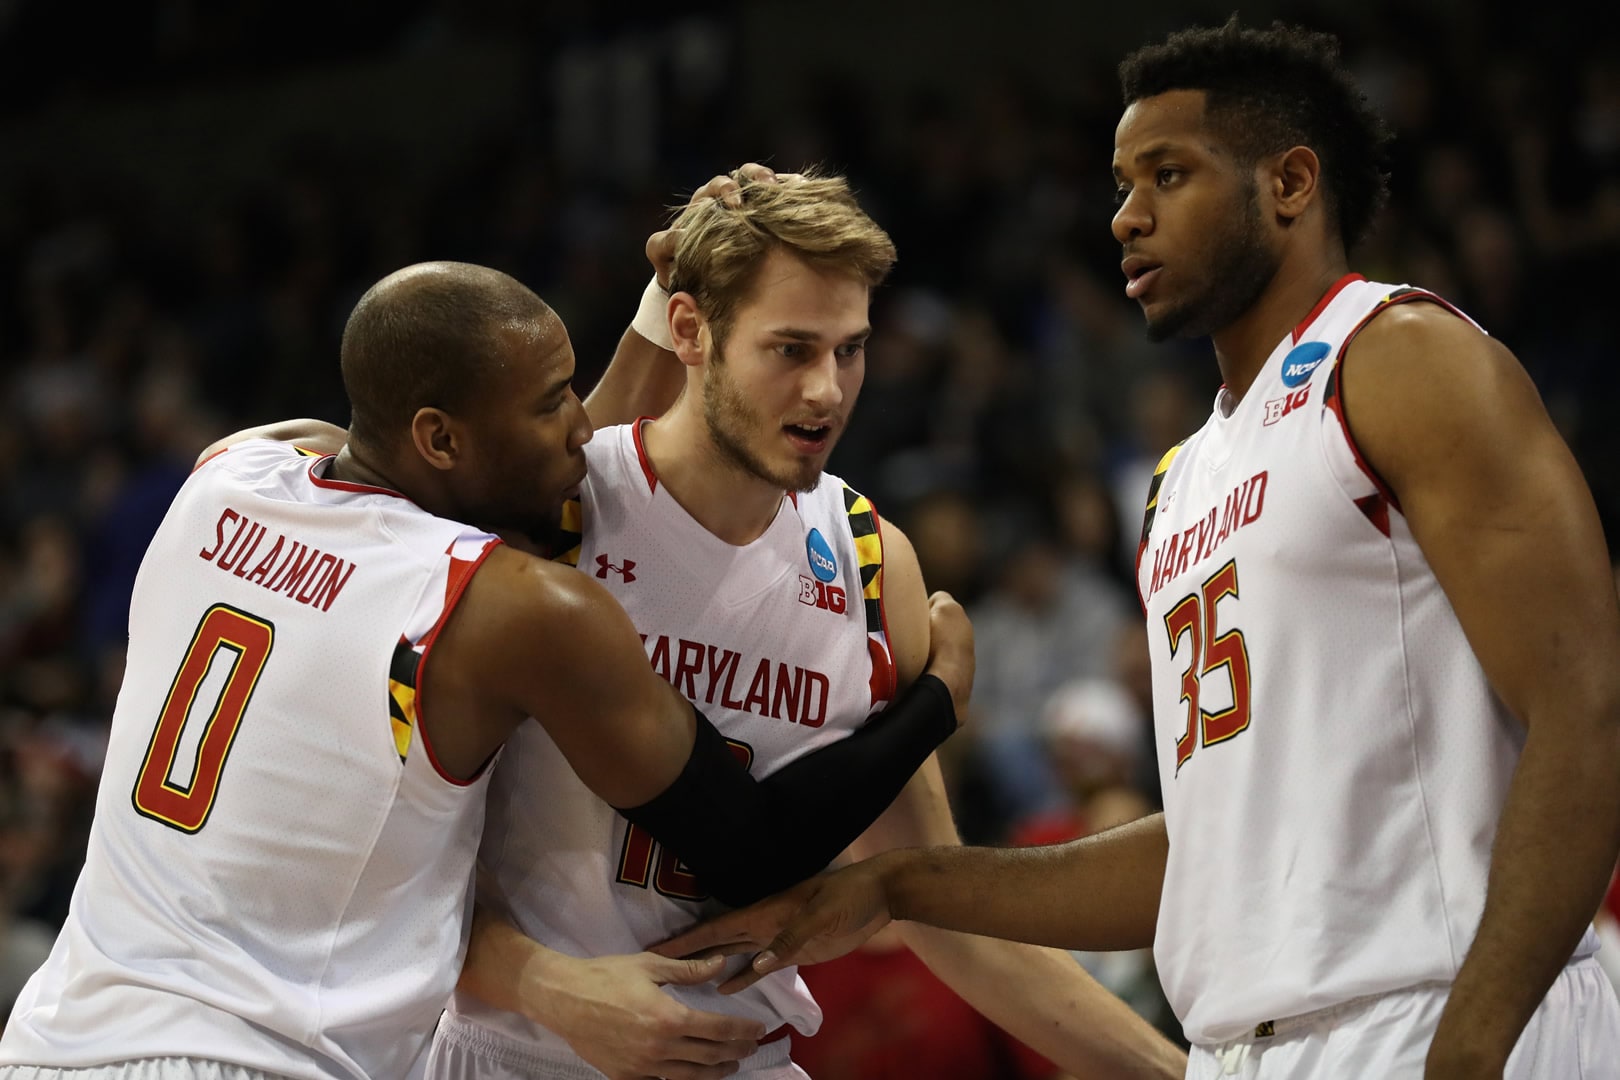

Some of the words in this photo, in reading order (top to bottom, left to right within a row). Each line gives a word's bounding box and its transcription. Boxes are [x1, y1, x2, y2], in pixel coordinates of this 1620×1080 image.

[199, 507, 357, 613] SULAIMON
[810, 547, 835, 573] NCAA
[1147, 470, 1268, 603] MARYLAND
[131, 602, 275, 836] 0
[639, 633, 830, 729] ARYLAND
[1164, 557, 1251, 780] 35
